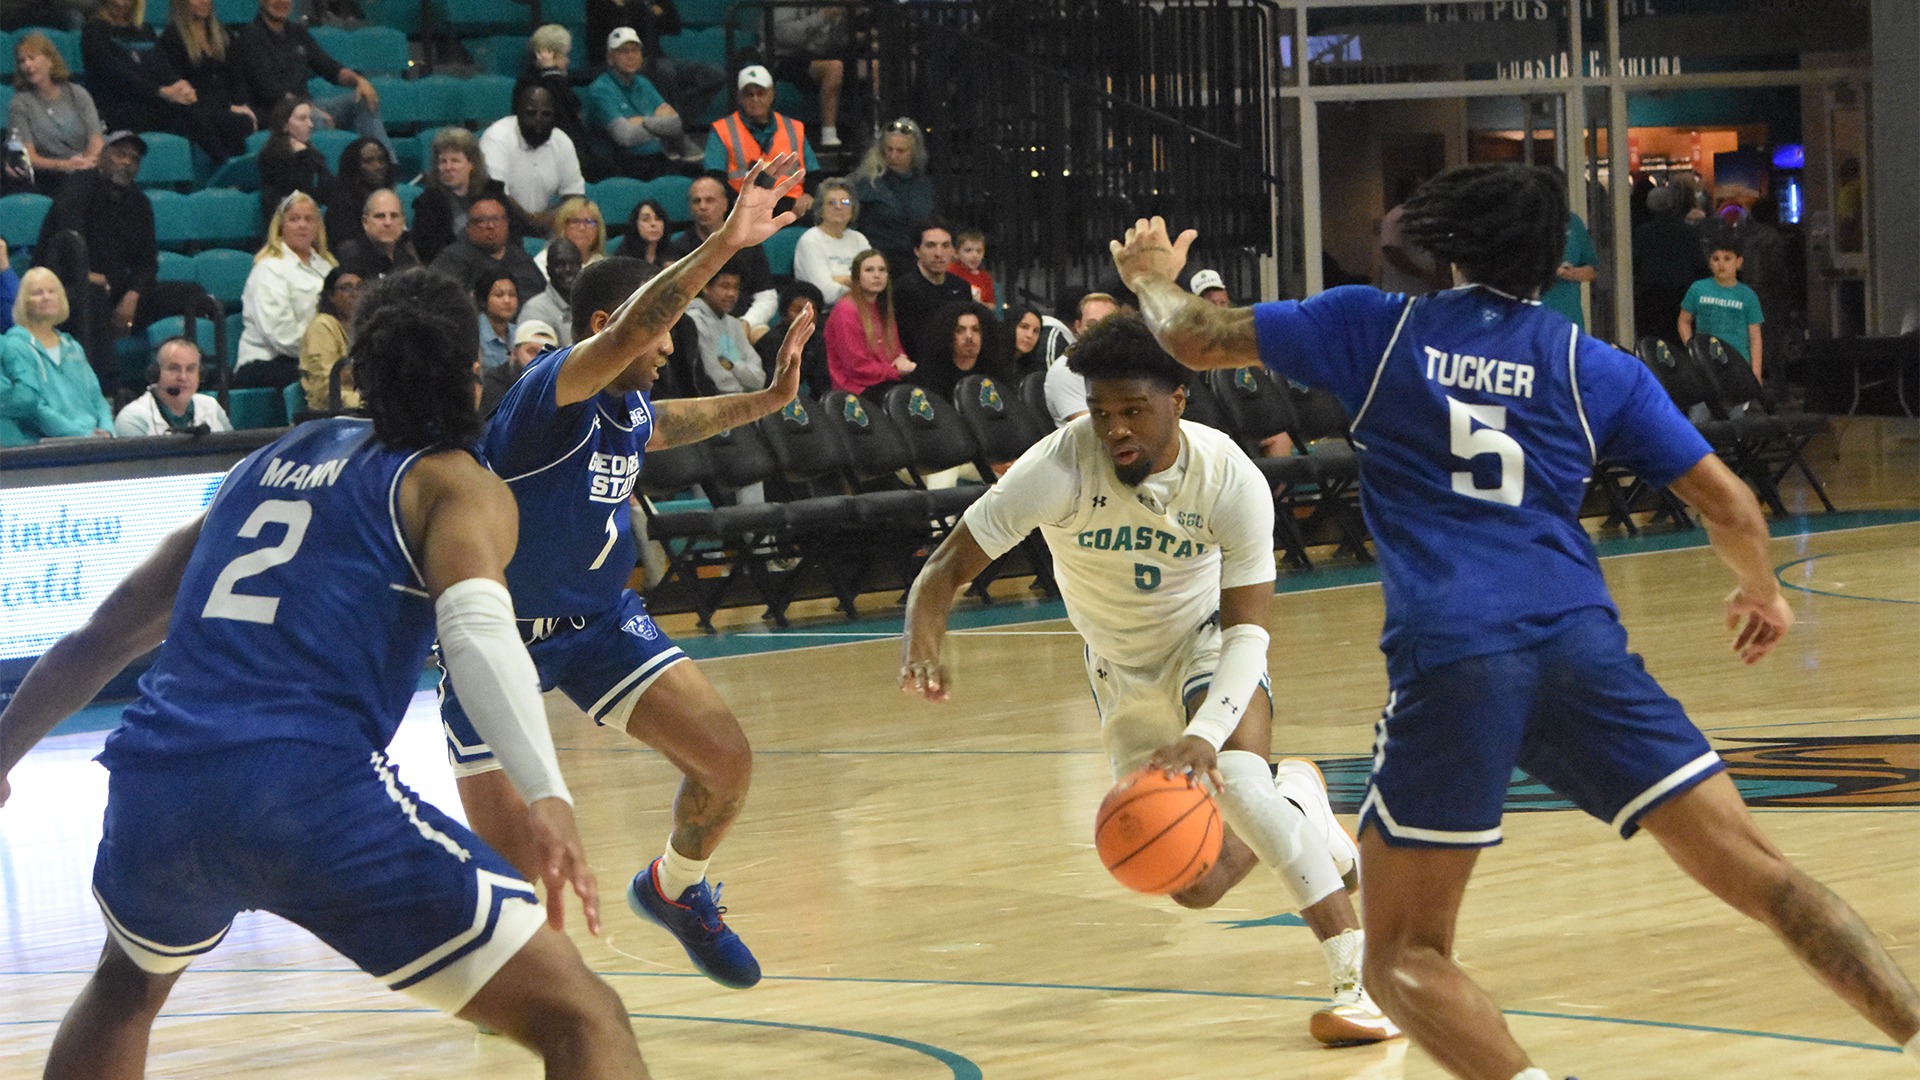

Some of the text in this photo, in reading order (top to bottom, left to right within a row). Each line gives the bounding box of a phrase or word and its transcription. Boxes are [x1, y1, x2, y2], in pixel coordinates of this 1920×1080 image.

[1497, 51, 1570, 80] COASTA
[1424, 345, 1535, 399] TUCKER
[629, 407, 648, 428] BC
[588, 451, 640, 477] GEOR
[1445, 394, 1525, 507] 5
[259, 457, 349, 490] MANN
[590, 469, 640, 498] STAT
[0, 504, 123, 556] indow
[588, 508, 618, 570] 1
[201, 499, 313, 625] 2
[1134, 563, 1162, 591] 5
[0, 559, 84, 609] orld
